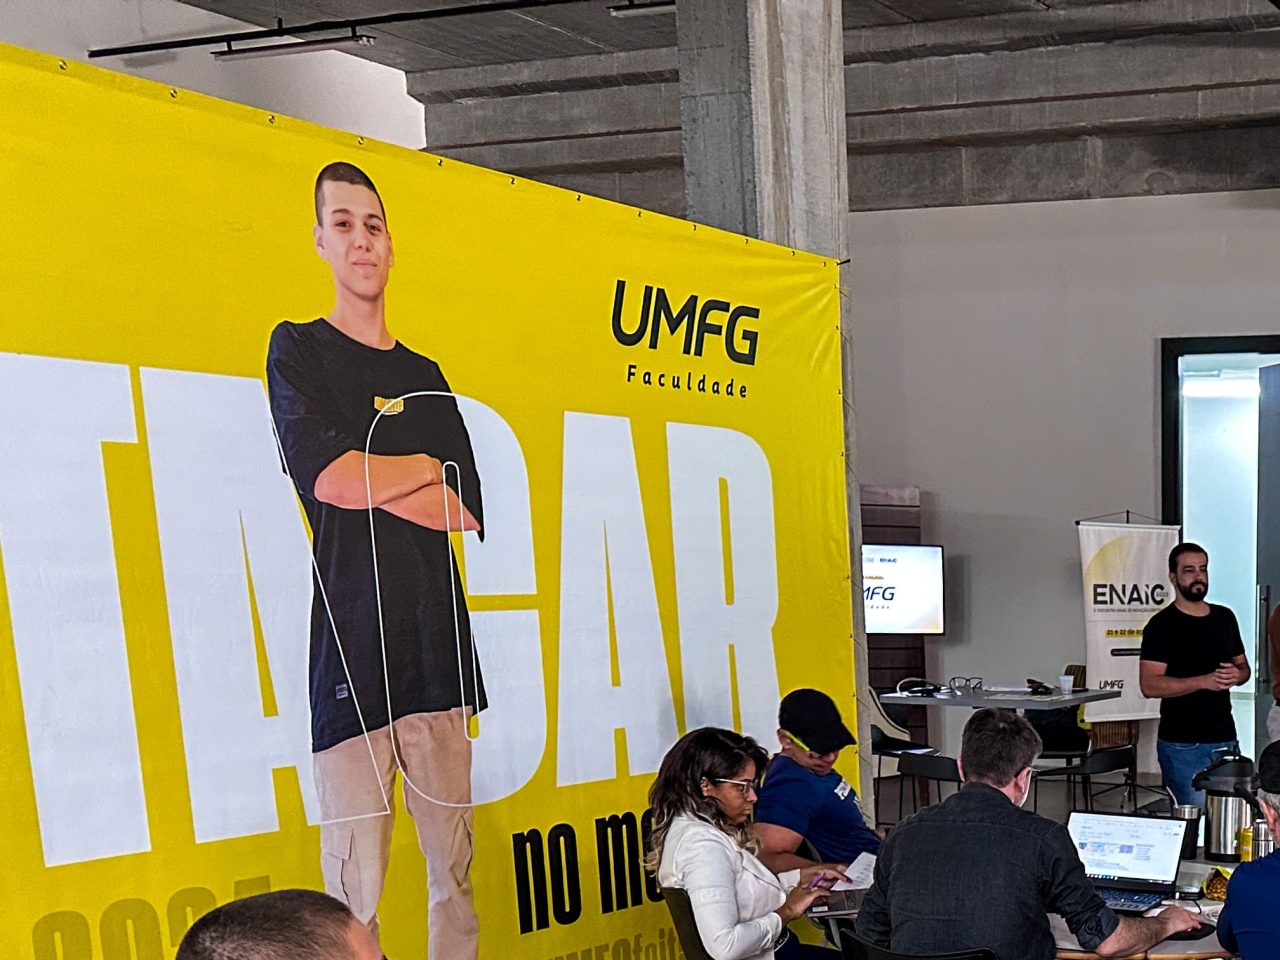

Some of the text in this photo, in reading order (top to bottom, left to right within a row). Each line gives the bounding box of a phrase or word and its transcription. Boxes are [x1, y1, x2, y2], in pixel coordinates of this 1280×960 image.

[611, 279, 760, 366] UMFG
[627, 363, 748, 399] Faculdade
[1099, 679, 1124, 690] UMFG
[512, 822, 582, 936] no
